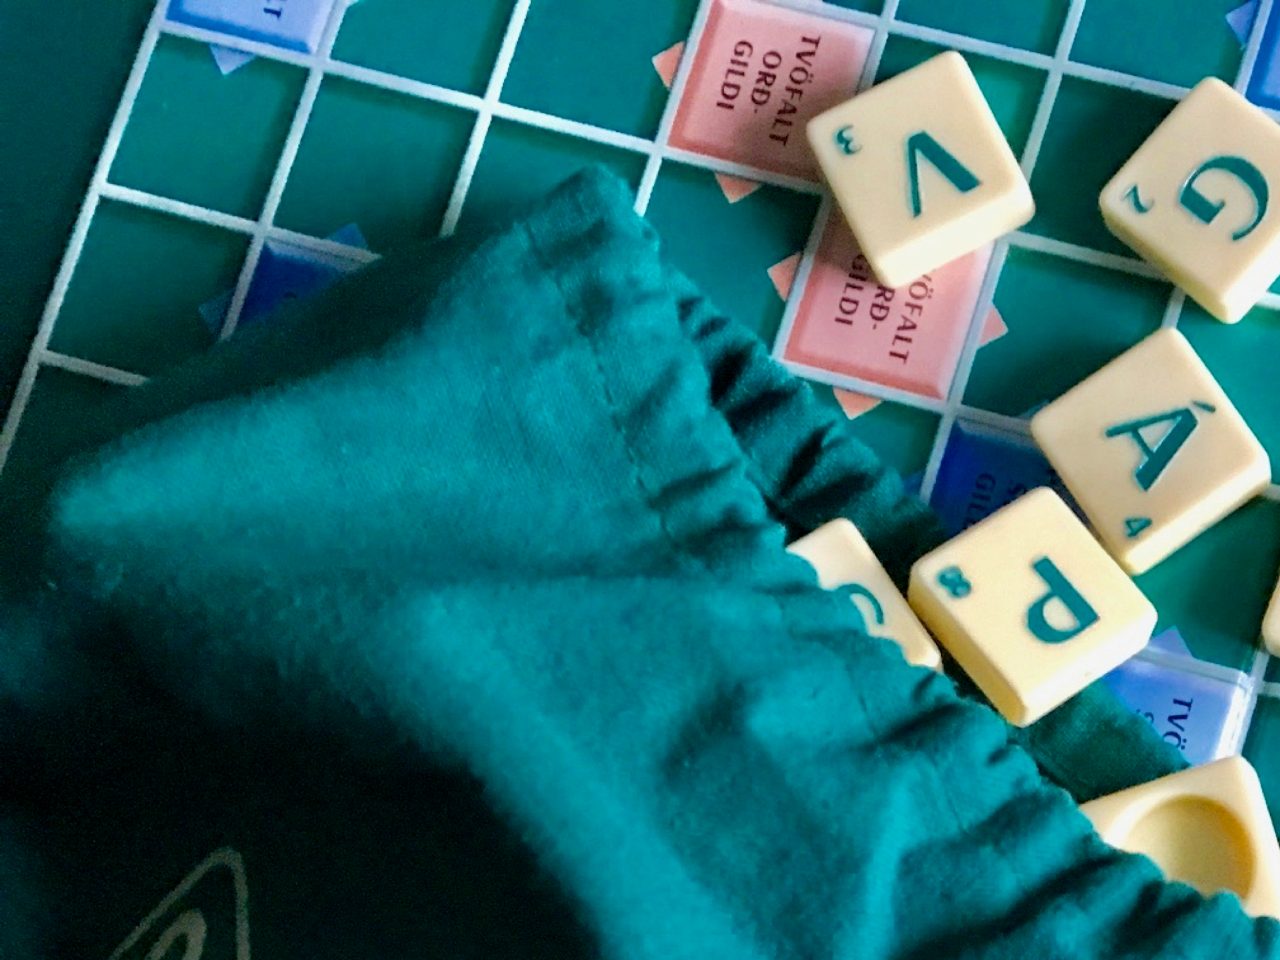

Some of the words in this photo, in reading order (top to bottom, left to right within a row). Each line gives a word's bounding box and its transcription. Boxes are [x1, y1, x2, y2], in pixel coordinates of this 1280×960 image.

[716, 40, 754, 110] GILDI
[769, 36, 821, 146] TVÖFALT
[905, 131, 981, 218] V
[1179, 155, 1270, 241] G
[889, 274, 934, 364] ÖFALT
[1105, 400, 1216, 492] Á
[1026, 555, 1100, 645] P
